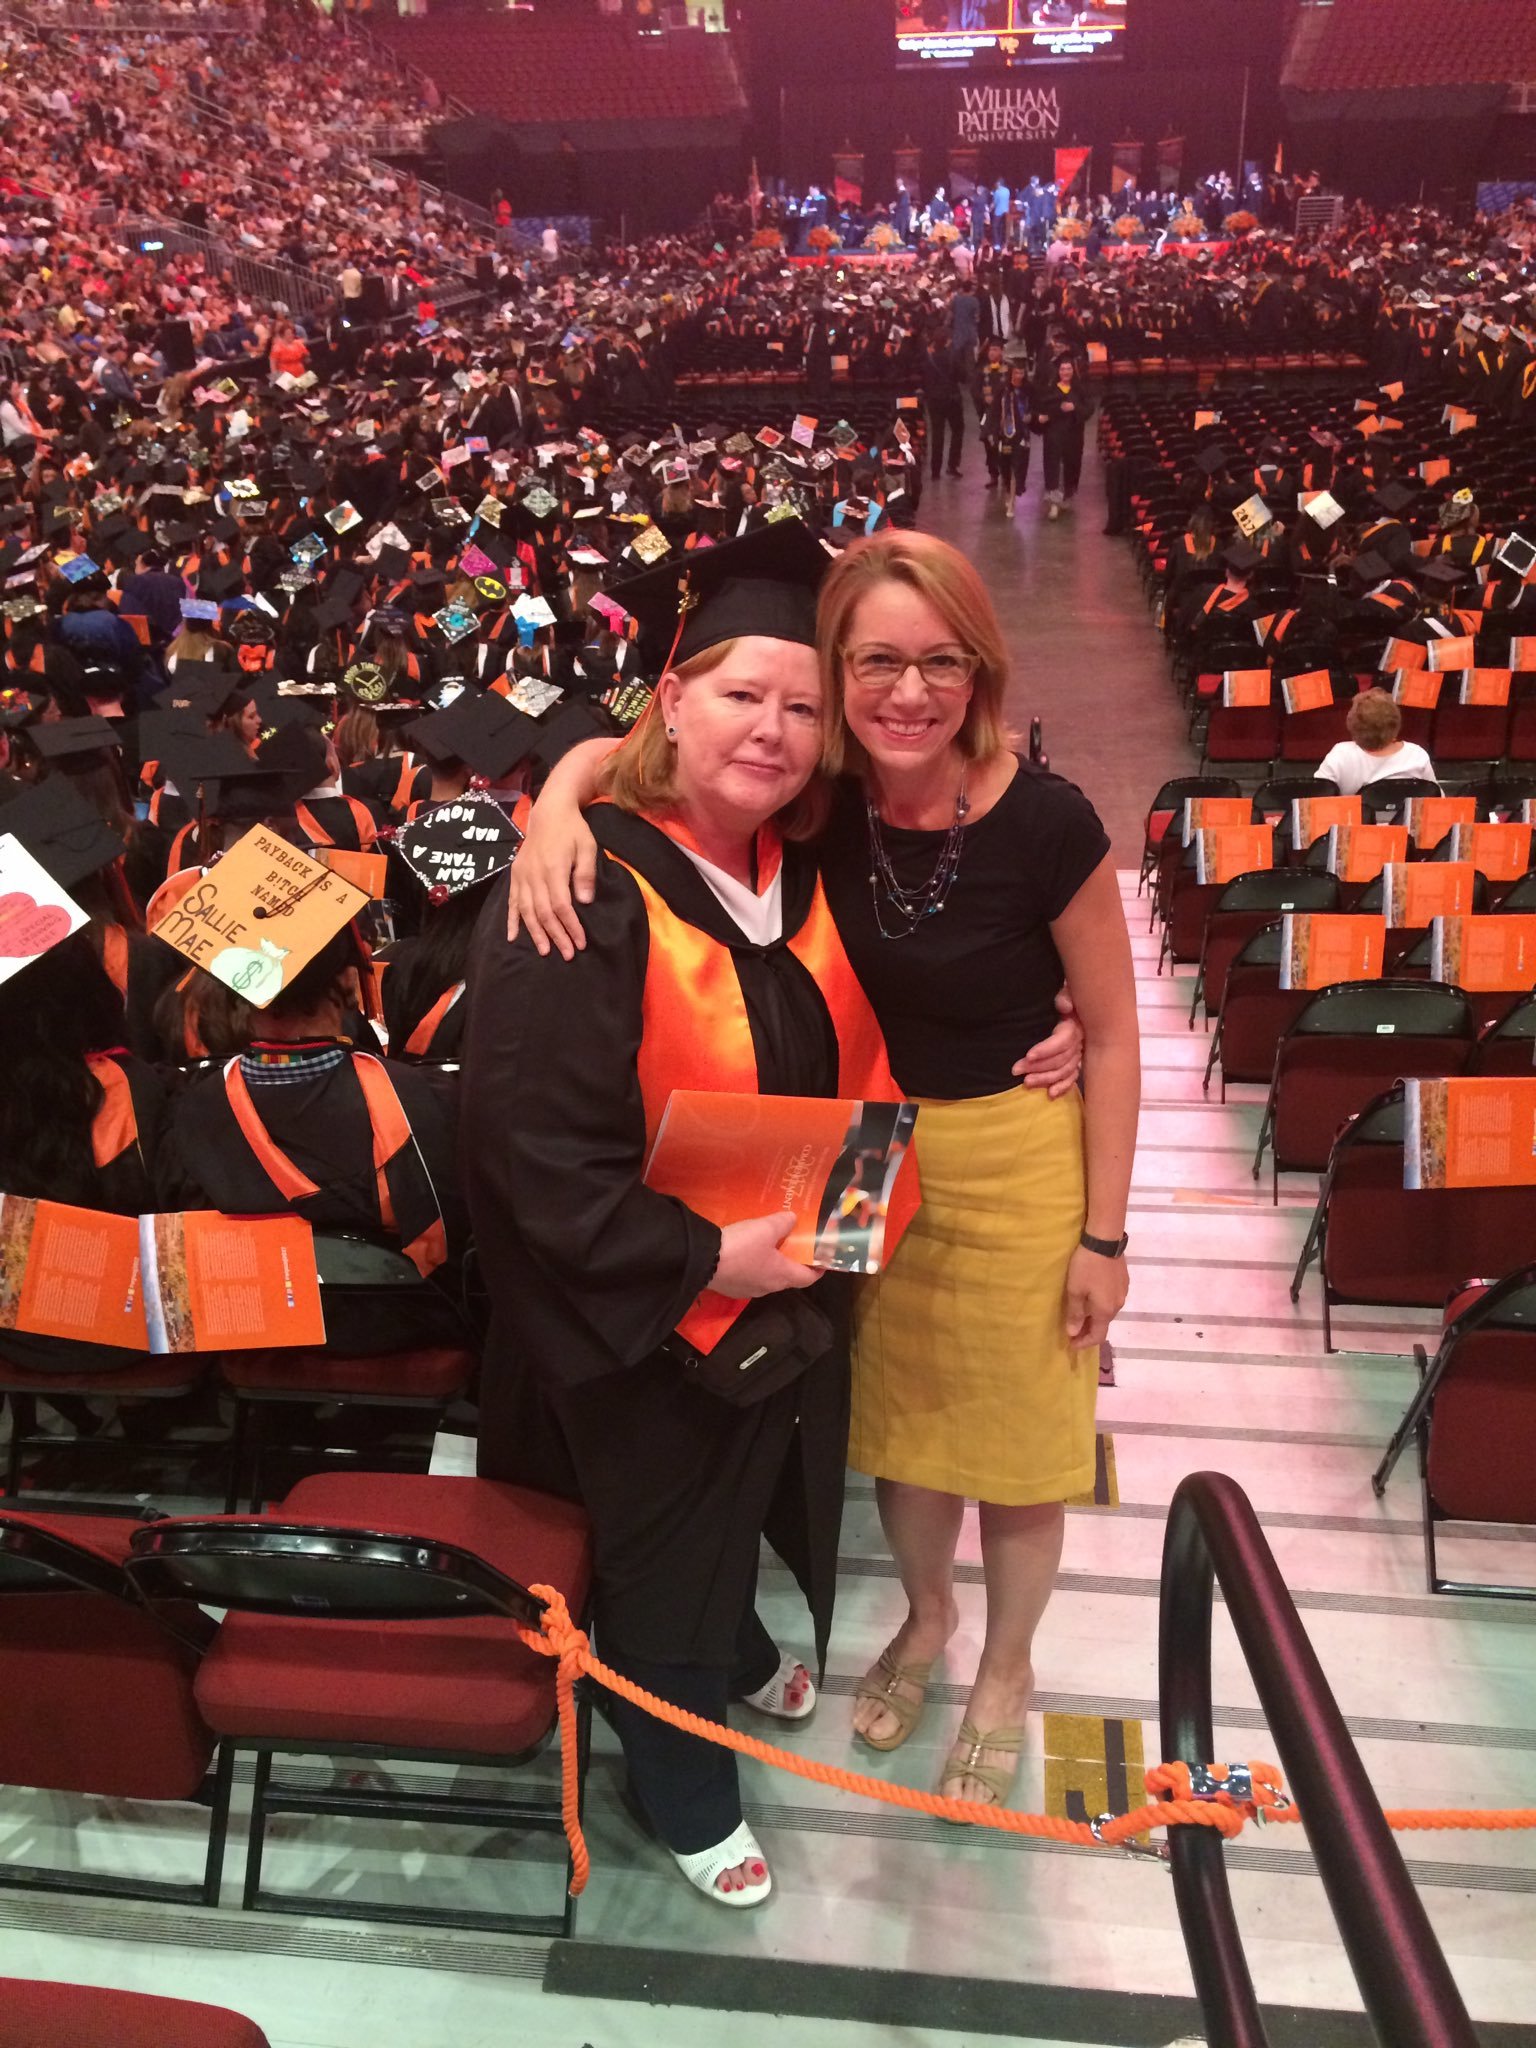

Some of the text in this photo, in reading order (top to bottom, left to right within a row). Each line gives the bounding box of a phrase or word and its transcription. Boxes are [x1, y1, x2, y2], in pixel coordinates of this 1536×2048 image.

[961, 86, 1057, 111] WILLIAM
[958, 107, 1060, 136] PATERSON
[966, 130, 1058, 142] UNIVERSITY
[1236, 508, 1256, 531] 2017
[462, 825, 500, 842] NAP
[412, 845, 428, 859] A
[429, 851, 476, 867] TAKE
[254, 836, 313, 879] PAYBACK
[336, 893, 348, 904] A
[436, 868, 476, 882] CAN
[183, 883, 248, 944] SALLIE
[155, 911, 214, 961] MAE
